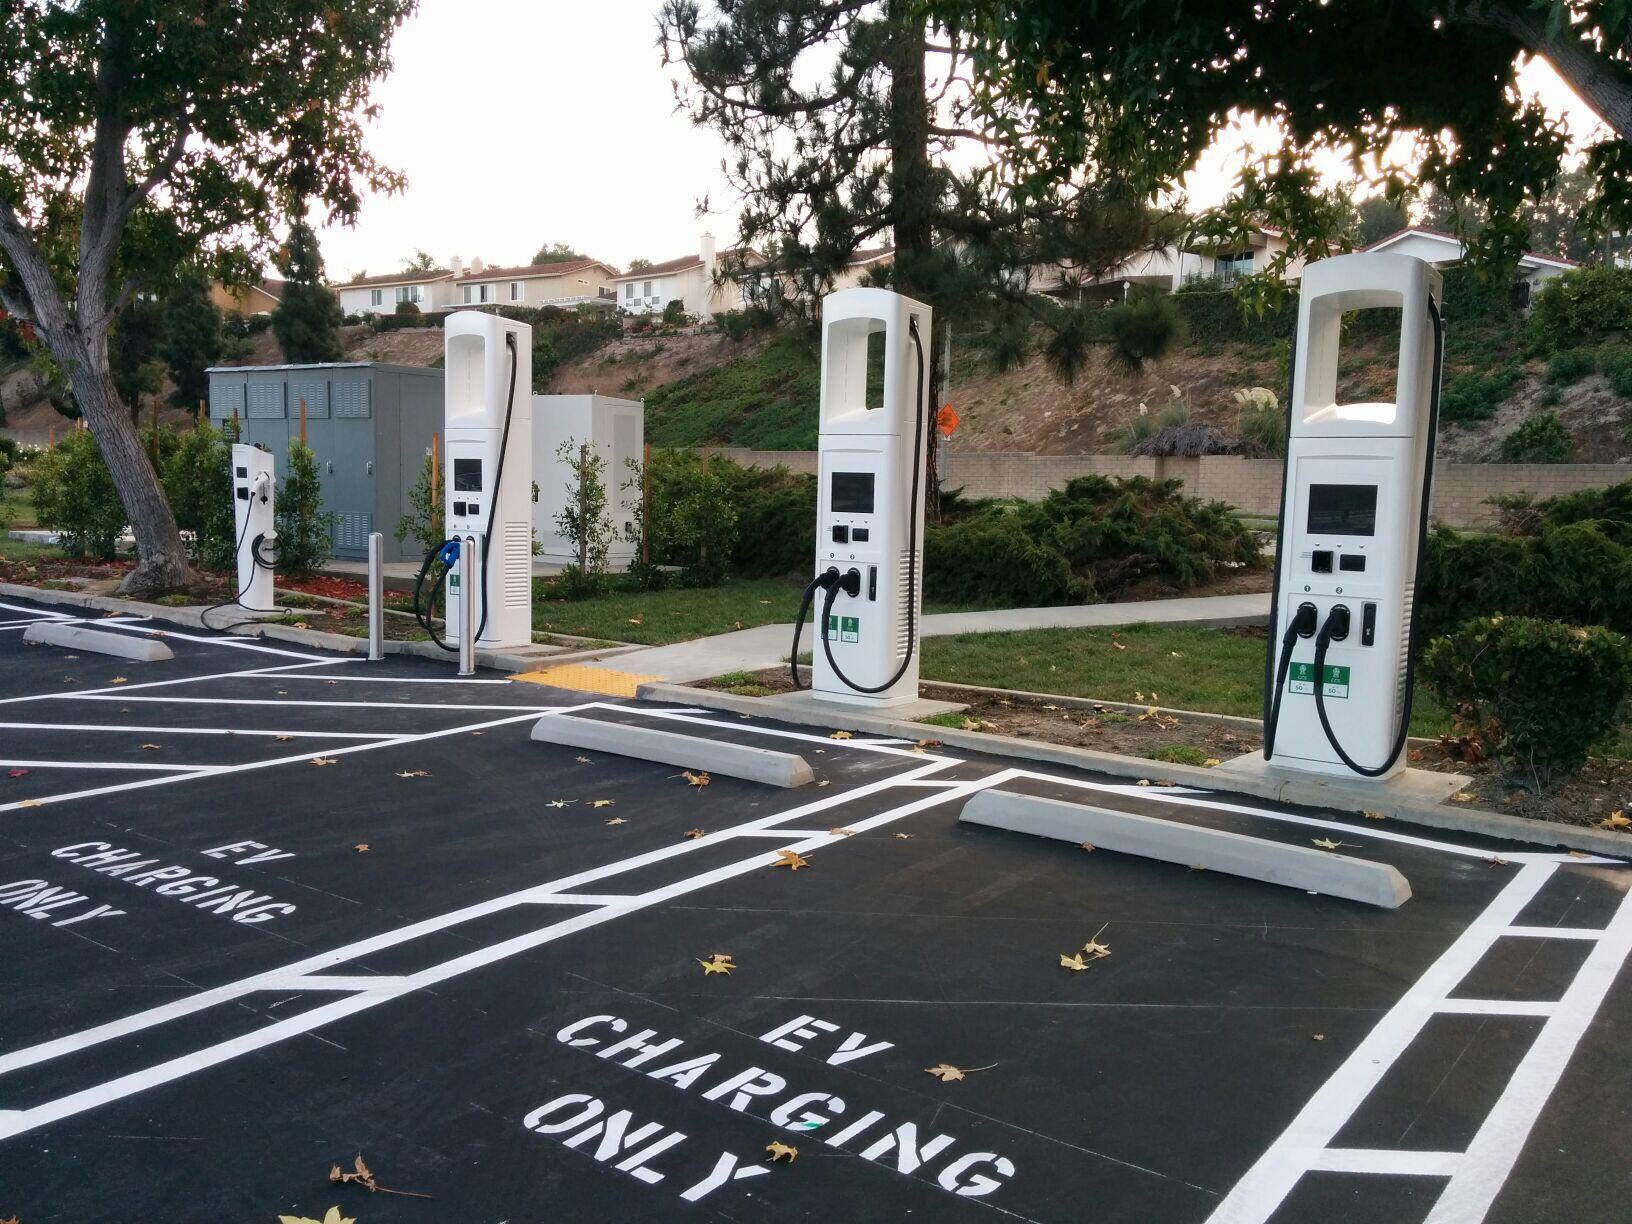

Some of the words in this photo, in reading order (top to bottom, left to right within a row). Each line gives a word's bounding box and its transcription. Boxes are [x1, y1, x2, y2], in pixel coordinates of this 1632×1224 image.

[51, 842, 296, 923] CHARGING
[201, 841, 295, 864] EV
[0, 880, 126, 926] ONLY
[759, 1015, 895, 1065] EV
[557, 1015, 1015, 1196] CHARGING
[524, 1094, 770, 1201] ONLY
